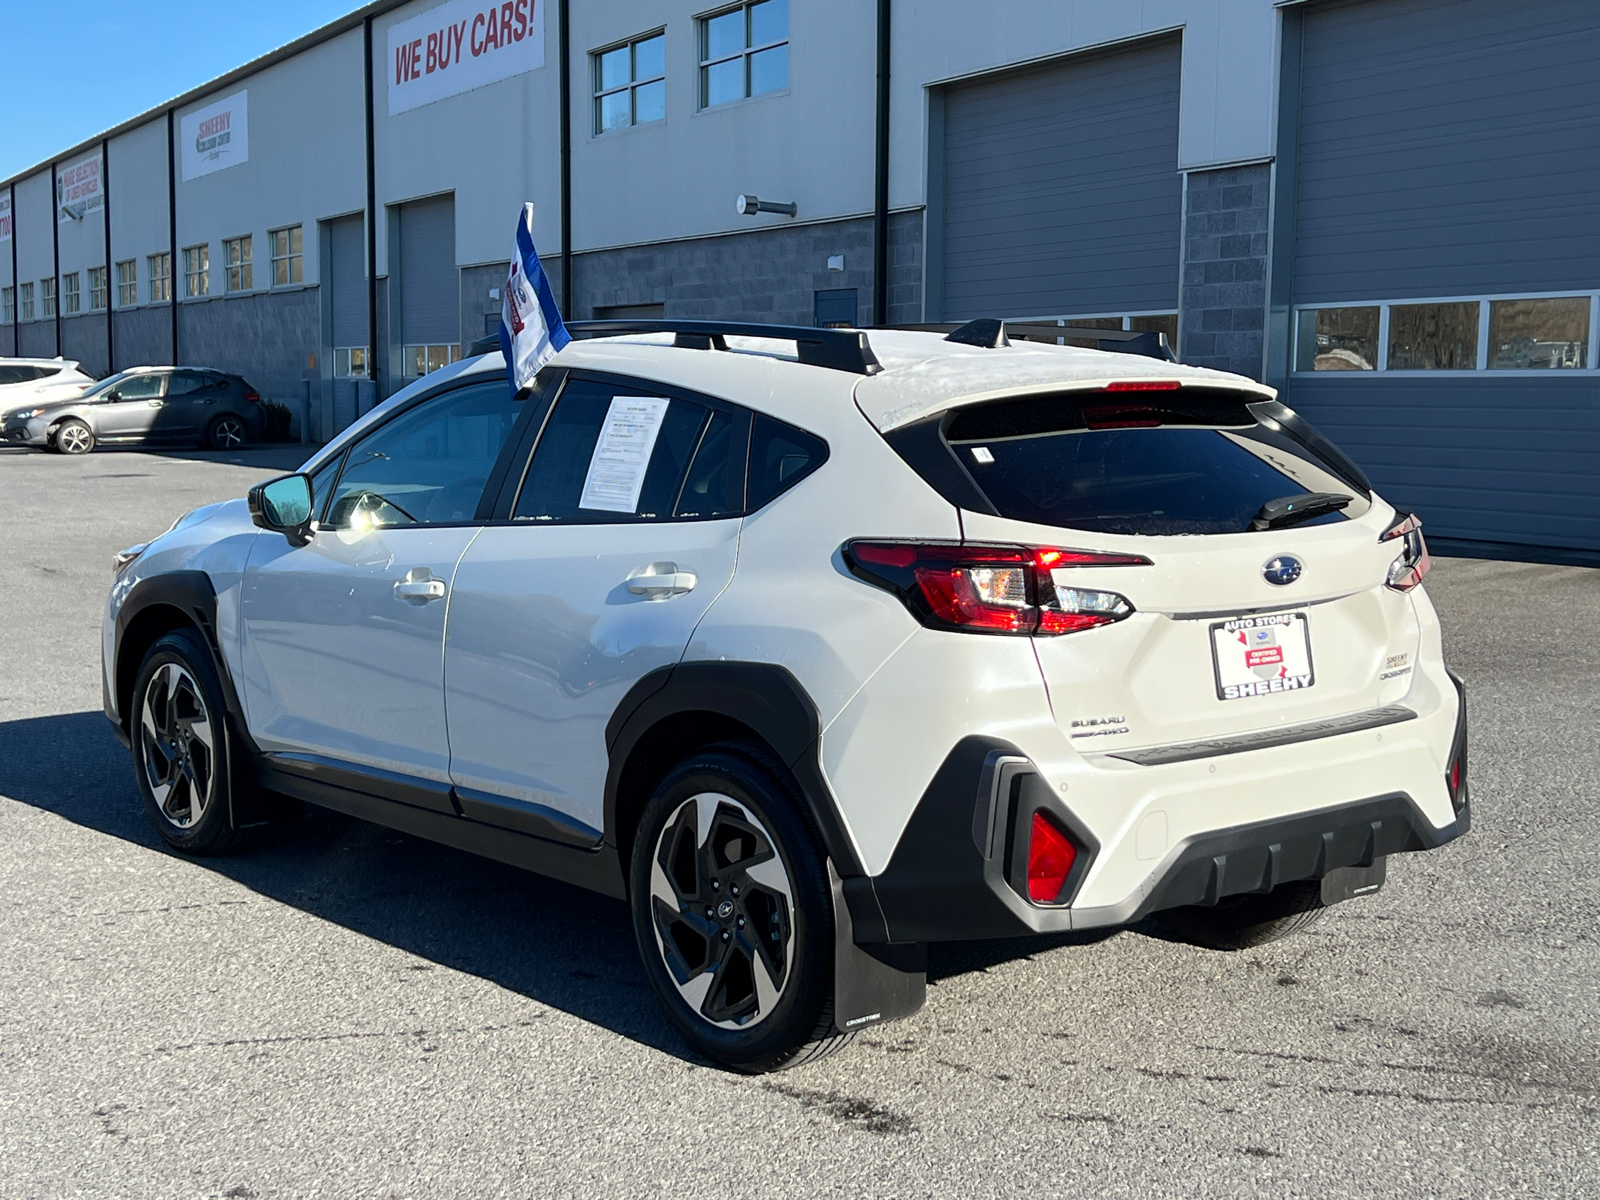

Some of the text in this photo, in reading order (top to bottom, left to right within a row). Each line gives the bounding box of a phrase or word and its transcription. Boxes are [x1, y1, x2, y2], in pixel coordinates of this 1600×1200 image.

[396, 0, 535, 85] WE BUY CARS!
[199, 110, 231, 140] SHEEHY
[1224, 614, 1297, 631] AUTO STORES
[1249, 655, 1280, 664] PRE-OWNED
[1251, 649, 1277, 658] CERTIFIED
[1224, 674, 1312, 699] SHEEHY
[1071, 715, 1126, 728] SUBARU
